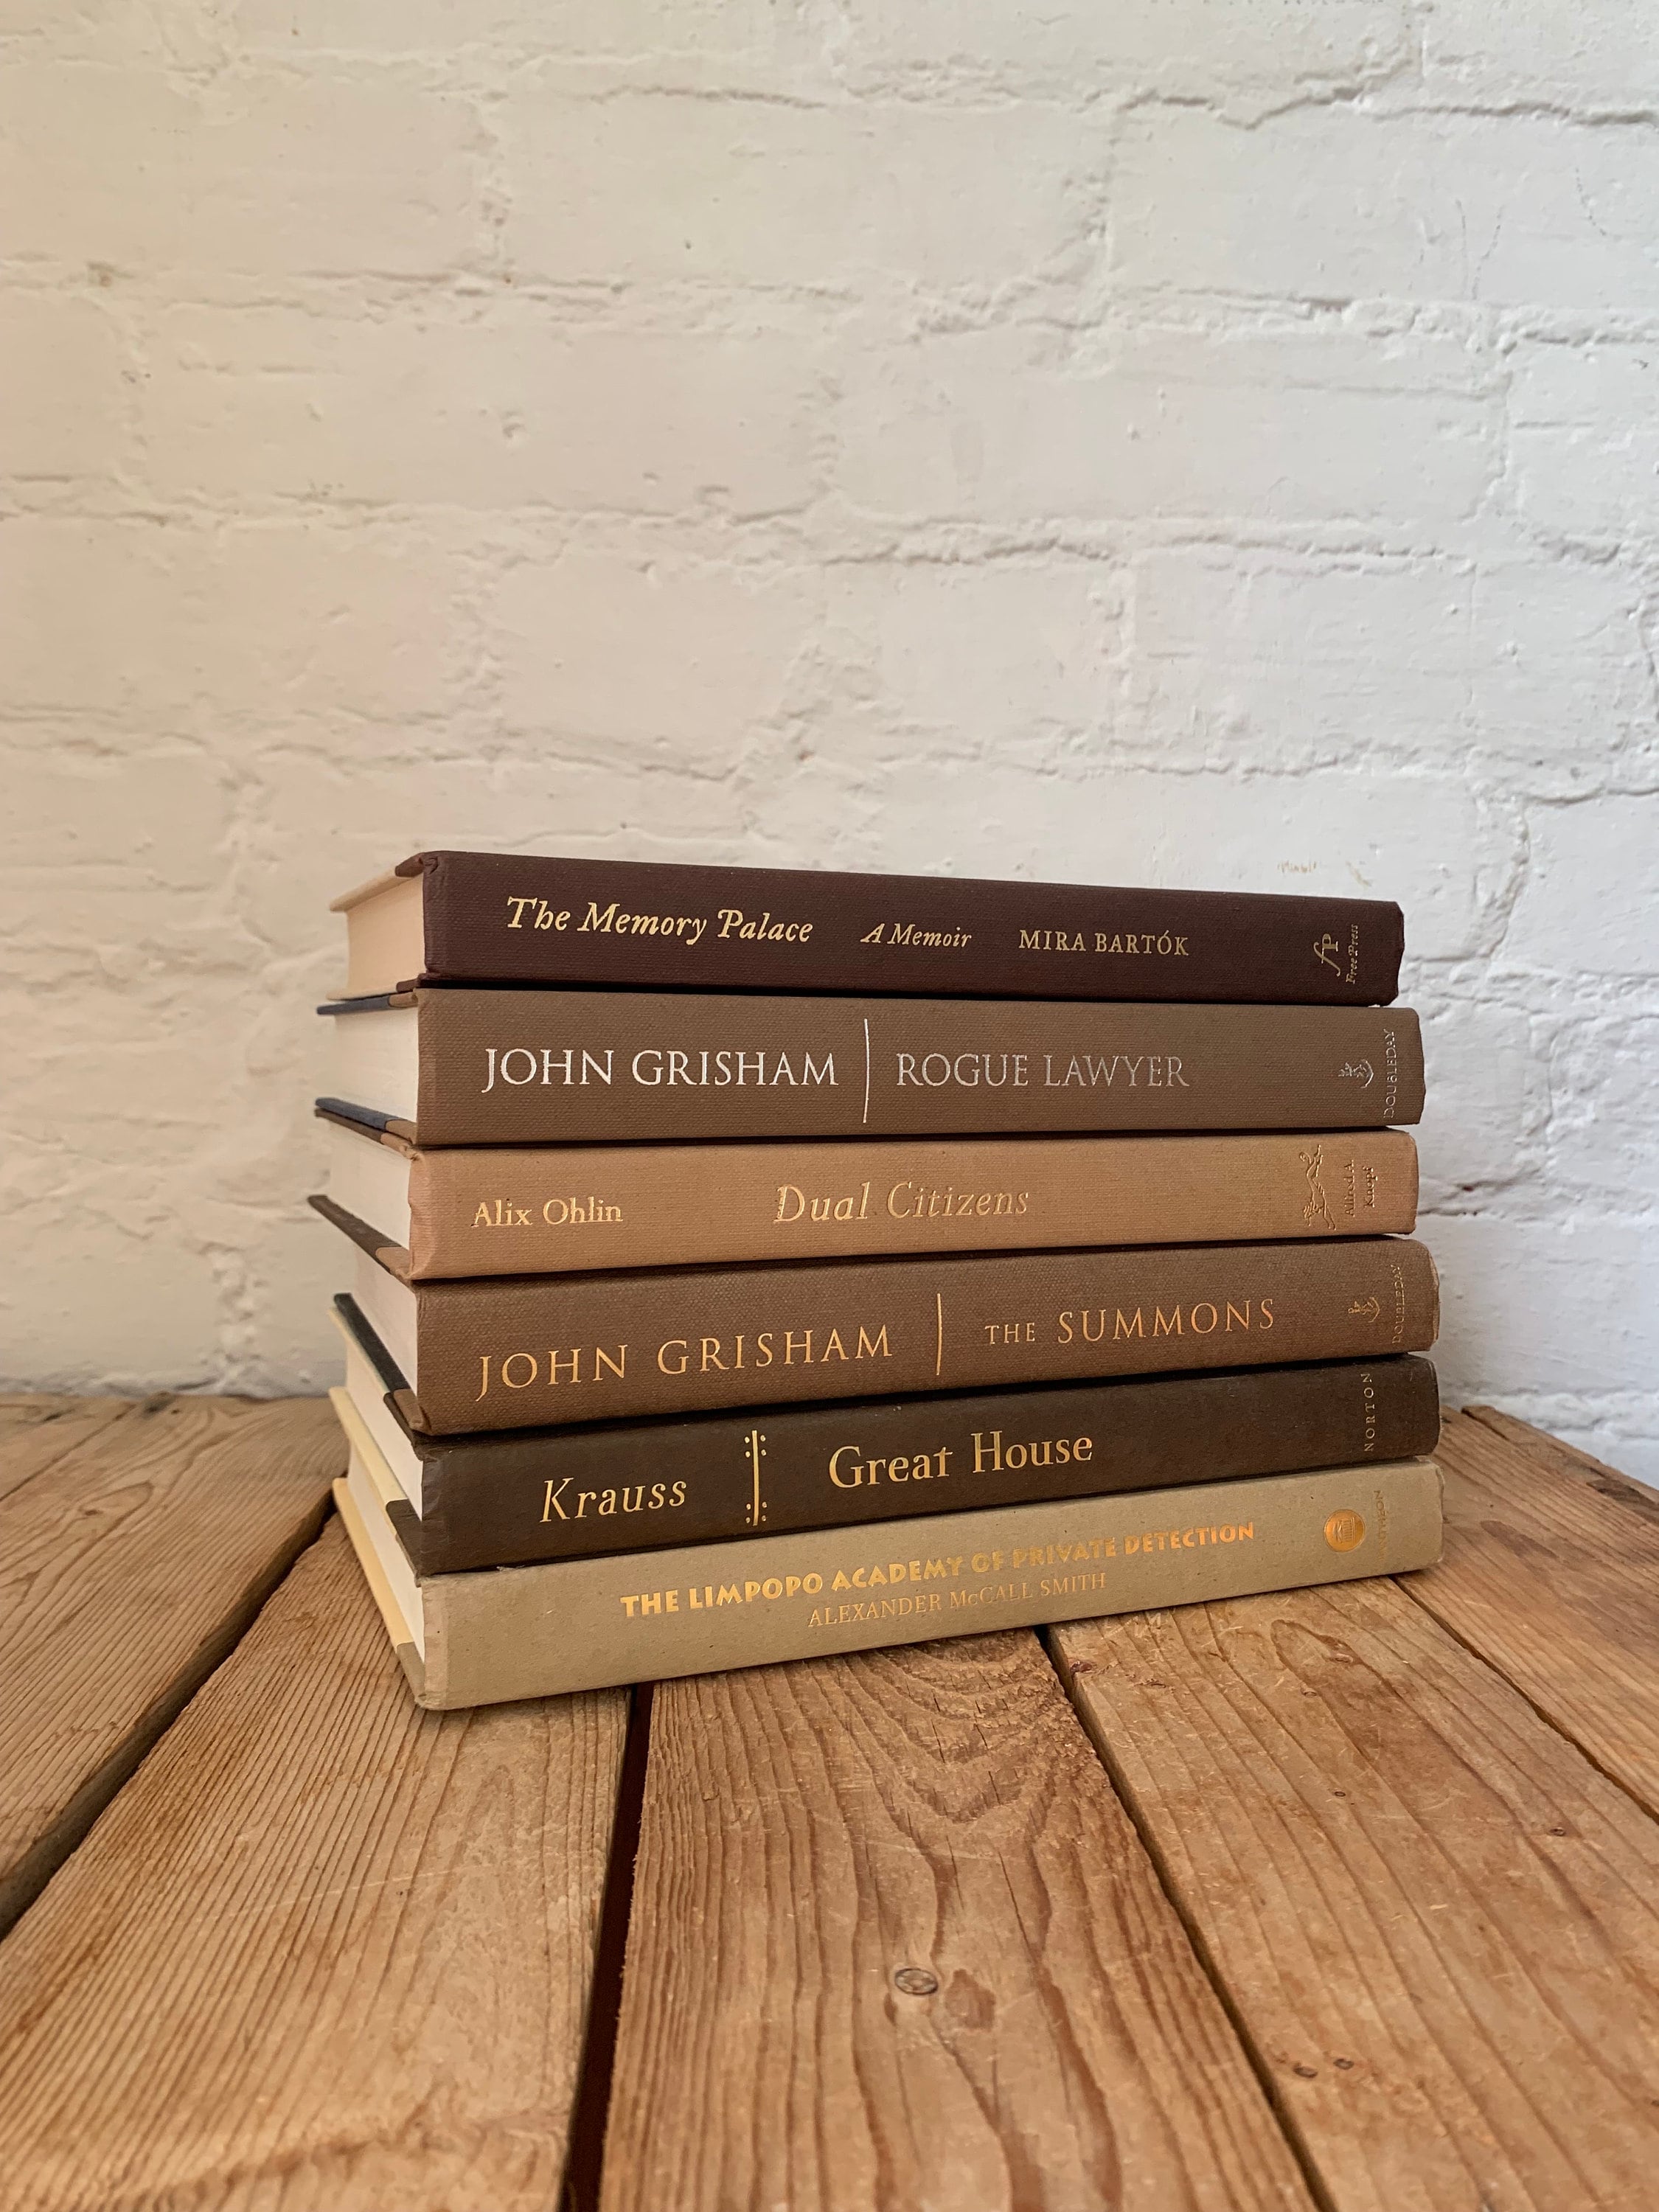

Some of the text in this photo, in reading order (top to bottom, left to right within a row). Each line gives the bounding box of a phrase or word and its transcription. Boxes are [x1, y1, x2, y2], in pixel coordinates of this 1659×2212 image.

[507, 897, 813, 945] The Memory Palace
[860, 923, 972, 949] A Memoir
[1019, 930, 1189, 956] MIRA BARTÓK
[1346, 924, 1358, 984] Free Press
[481, 1048, 839, 1093] JOHN GRISHAM
[896, 1053, 1190, 1087] ROGUE LAWYER
[1383, 1029, 1398, 1119] DOUBLEDAY
[773, 1182, 1029, 1223] Dual Citizens
[1344, 1176, 1355, 1217] Alfred
[1363, 1166, 1378, 1208] Knopf
[472, 1196, 623, 1227] Alix Ohlin
[985, 1298, 1275, 1344] THE SUMMONS
[1391, 1264, 1405, 1343] DOUBLEDAY
[474, 1324, 892, 1401] JOHN GRISHAM
[1360, 1373, 1375, 1452] NORTON
[829, 1430, 1093, 1489] Great House
[539, 1477, 687, 1523] Krauss
[620, 1521, 1253, 1617] THE LIMPOPO ACADEMY OF PRIVATE DETECTION
[807, 1572, 1106, 1628] ALEXANDER McCALL SMITH
